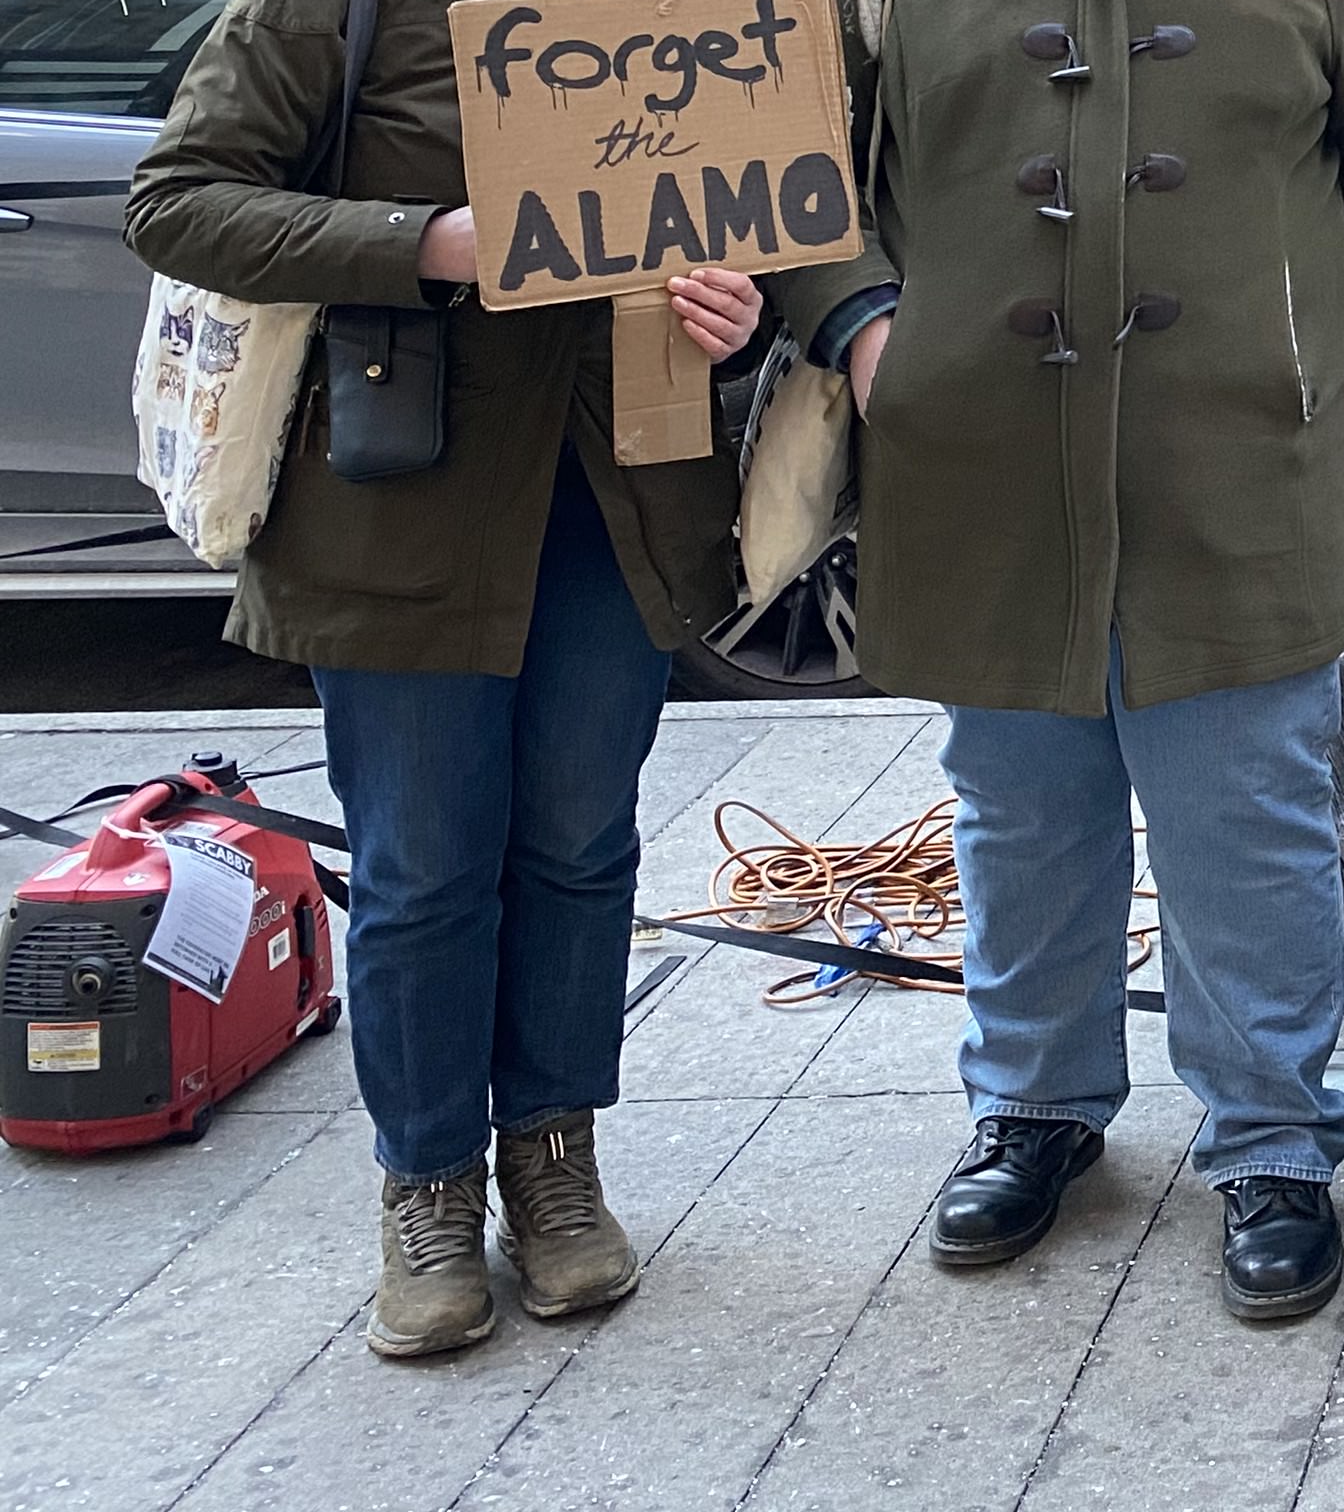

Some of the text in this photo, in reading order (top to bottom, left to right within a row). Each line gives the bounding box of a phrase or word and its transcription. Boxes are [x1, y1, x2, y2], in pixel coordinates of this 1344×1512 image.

[594, 118, 700, 170] the
[499, 151, 851, 292] ALAMO
[193, 839, 252, 876] SCABBY
